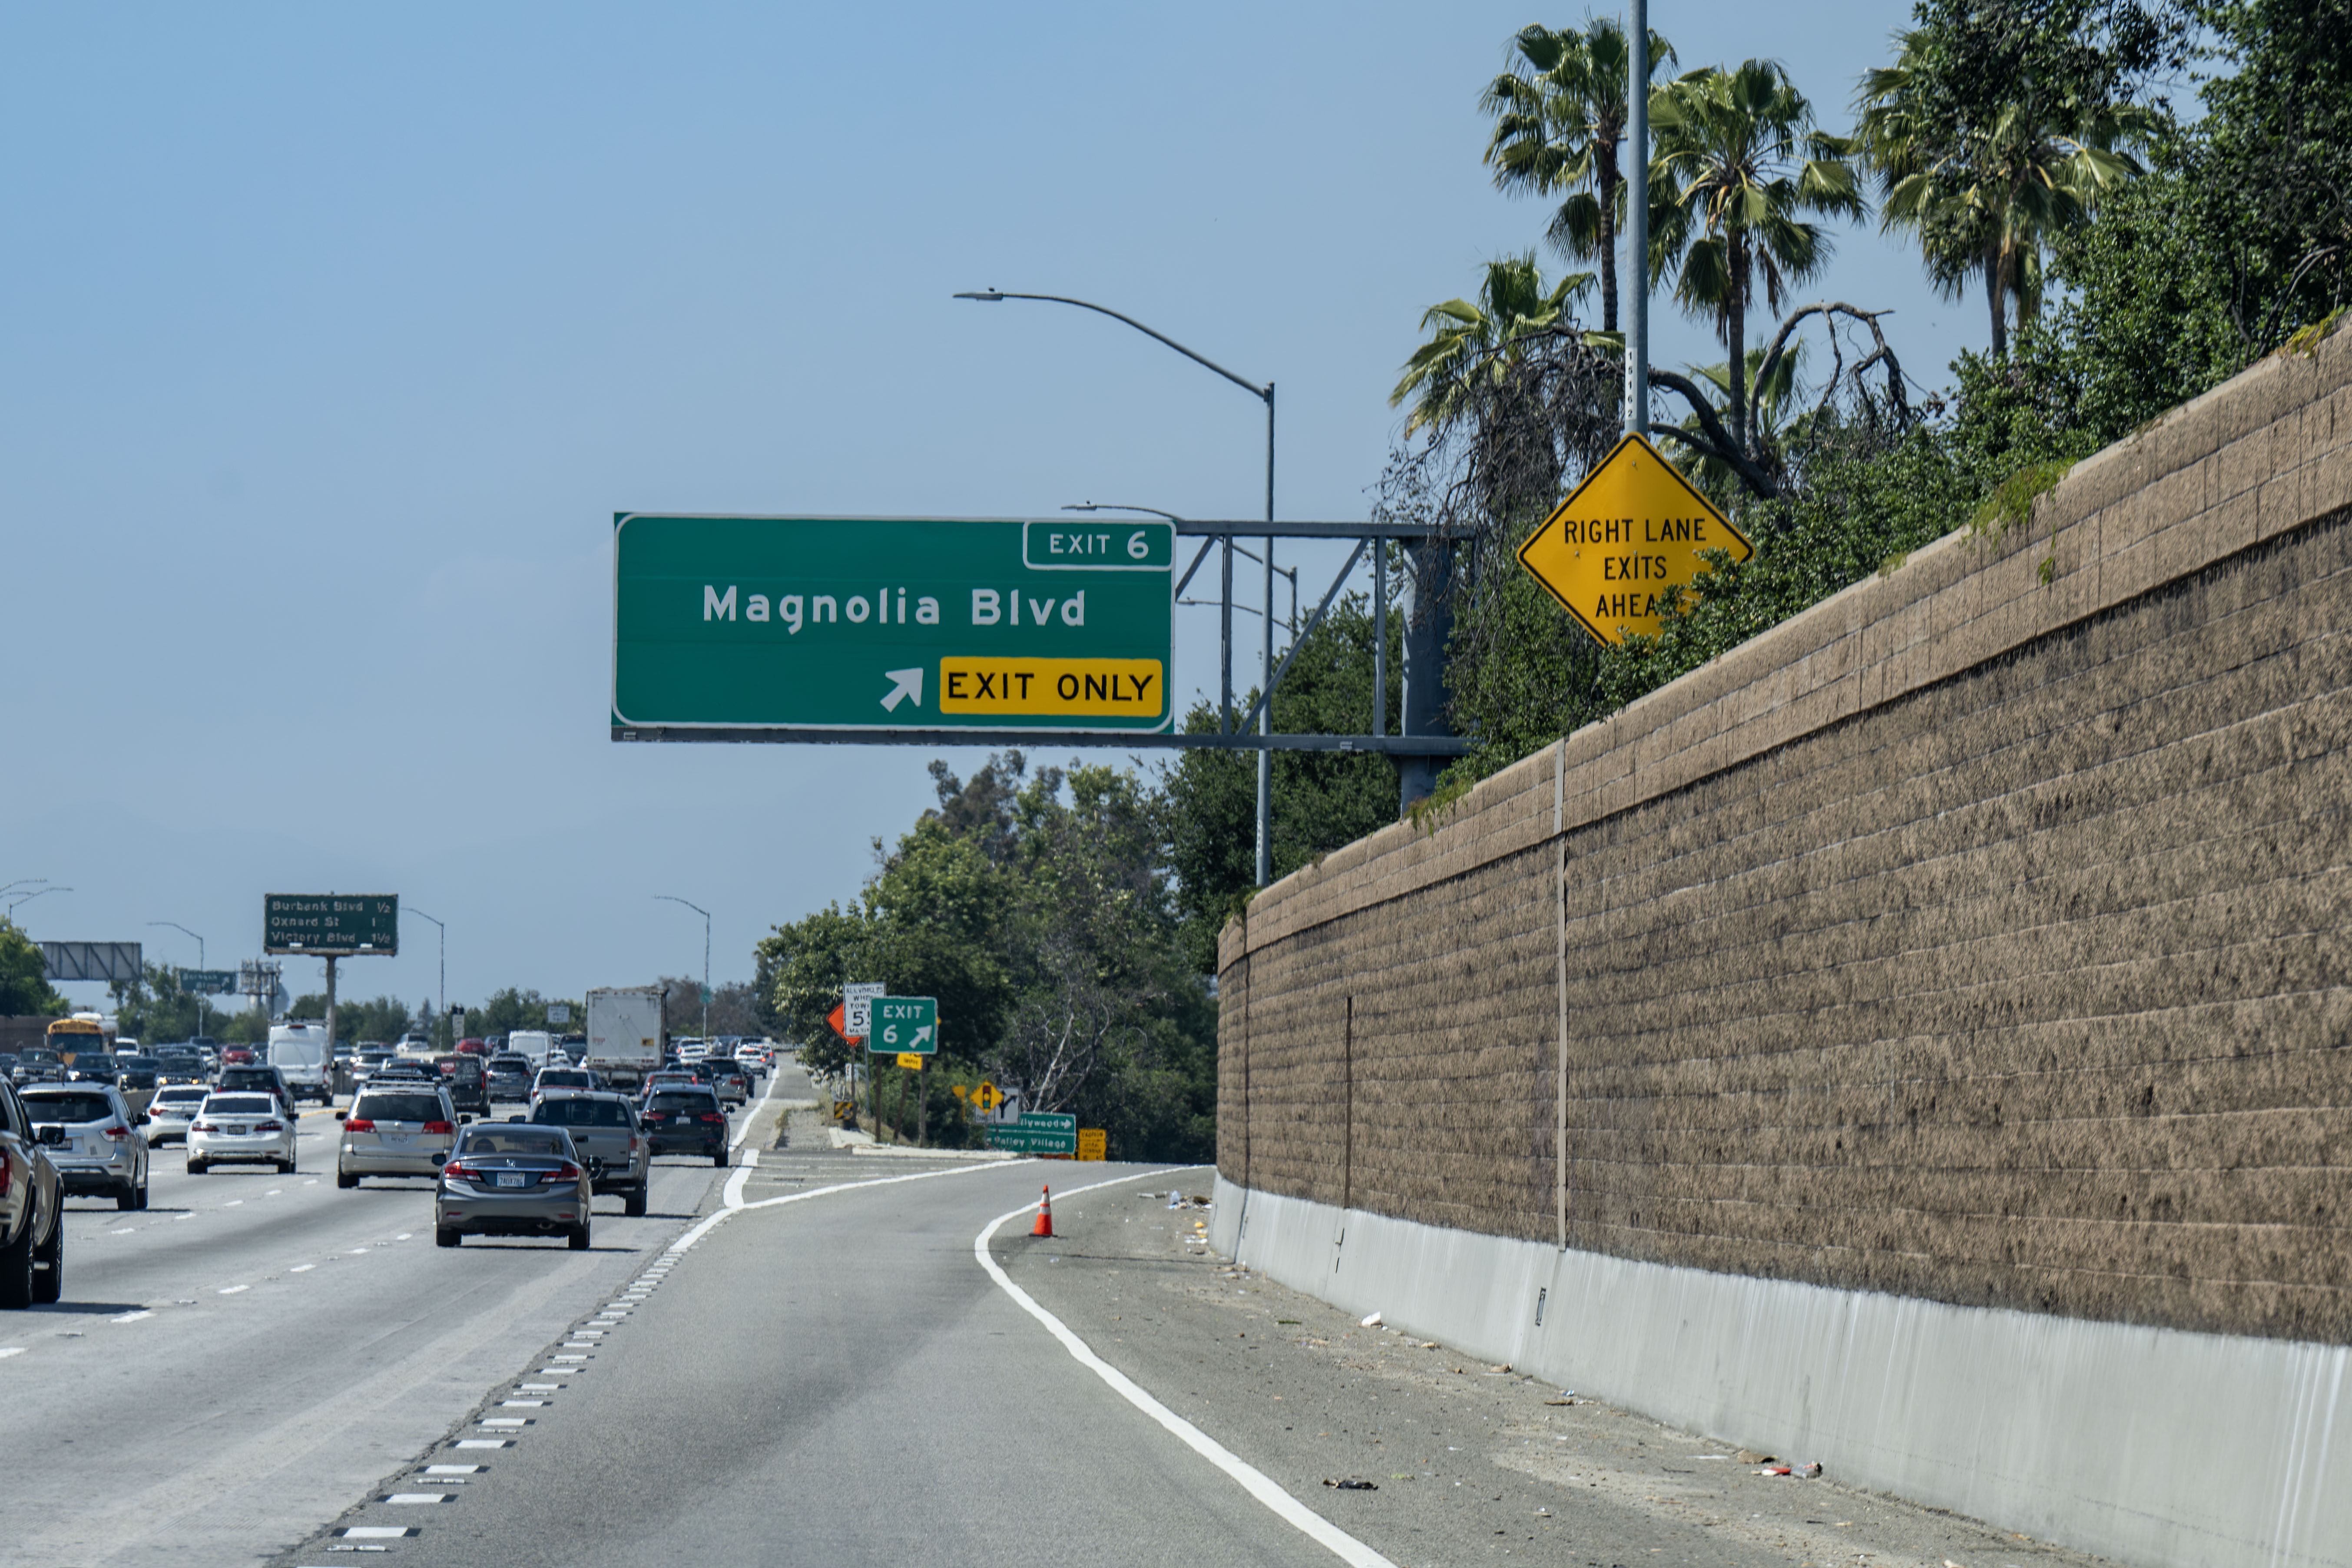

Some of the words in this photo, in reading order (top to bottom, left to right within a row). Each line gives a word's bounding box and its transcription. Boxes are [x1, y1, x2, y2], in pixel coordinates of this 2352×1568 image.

[1564, 518, 1633, 544] RIGHT
[1645, 518, 1706, 542] LANE
[1050, 534, 1110, 554] EXIT
[1127, 530, 1149, 559] 6
[1604, 556, 1667, 580] EXITS
[703, 585, 940, 635] Magnolia
[972, 589, 1085, 626] Blvd
[1595, 593, 1659, 618] AHEA
[948, 672, 1034, 699] EXIT
[1057, 673, 1154, 701] ONLY
[272, 901, 328, 912] Burbank
[333, 901, 363, 912] Blvd
[271, 916, 318, 927] Oxnard
[324, 916, 340, 927] St
[271, 931, 320, 944] Victory
[327, 932, 355, 943] Blvd
[883, 1005, 924, 1019] EXIT
[883, 1024, 898, 1044] 6
[1030, 1138, 1066, 1150] Village
